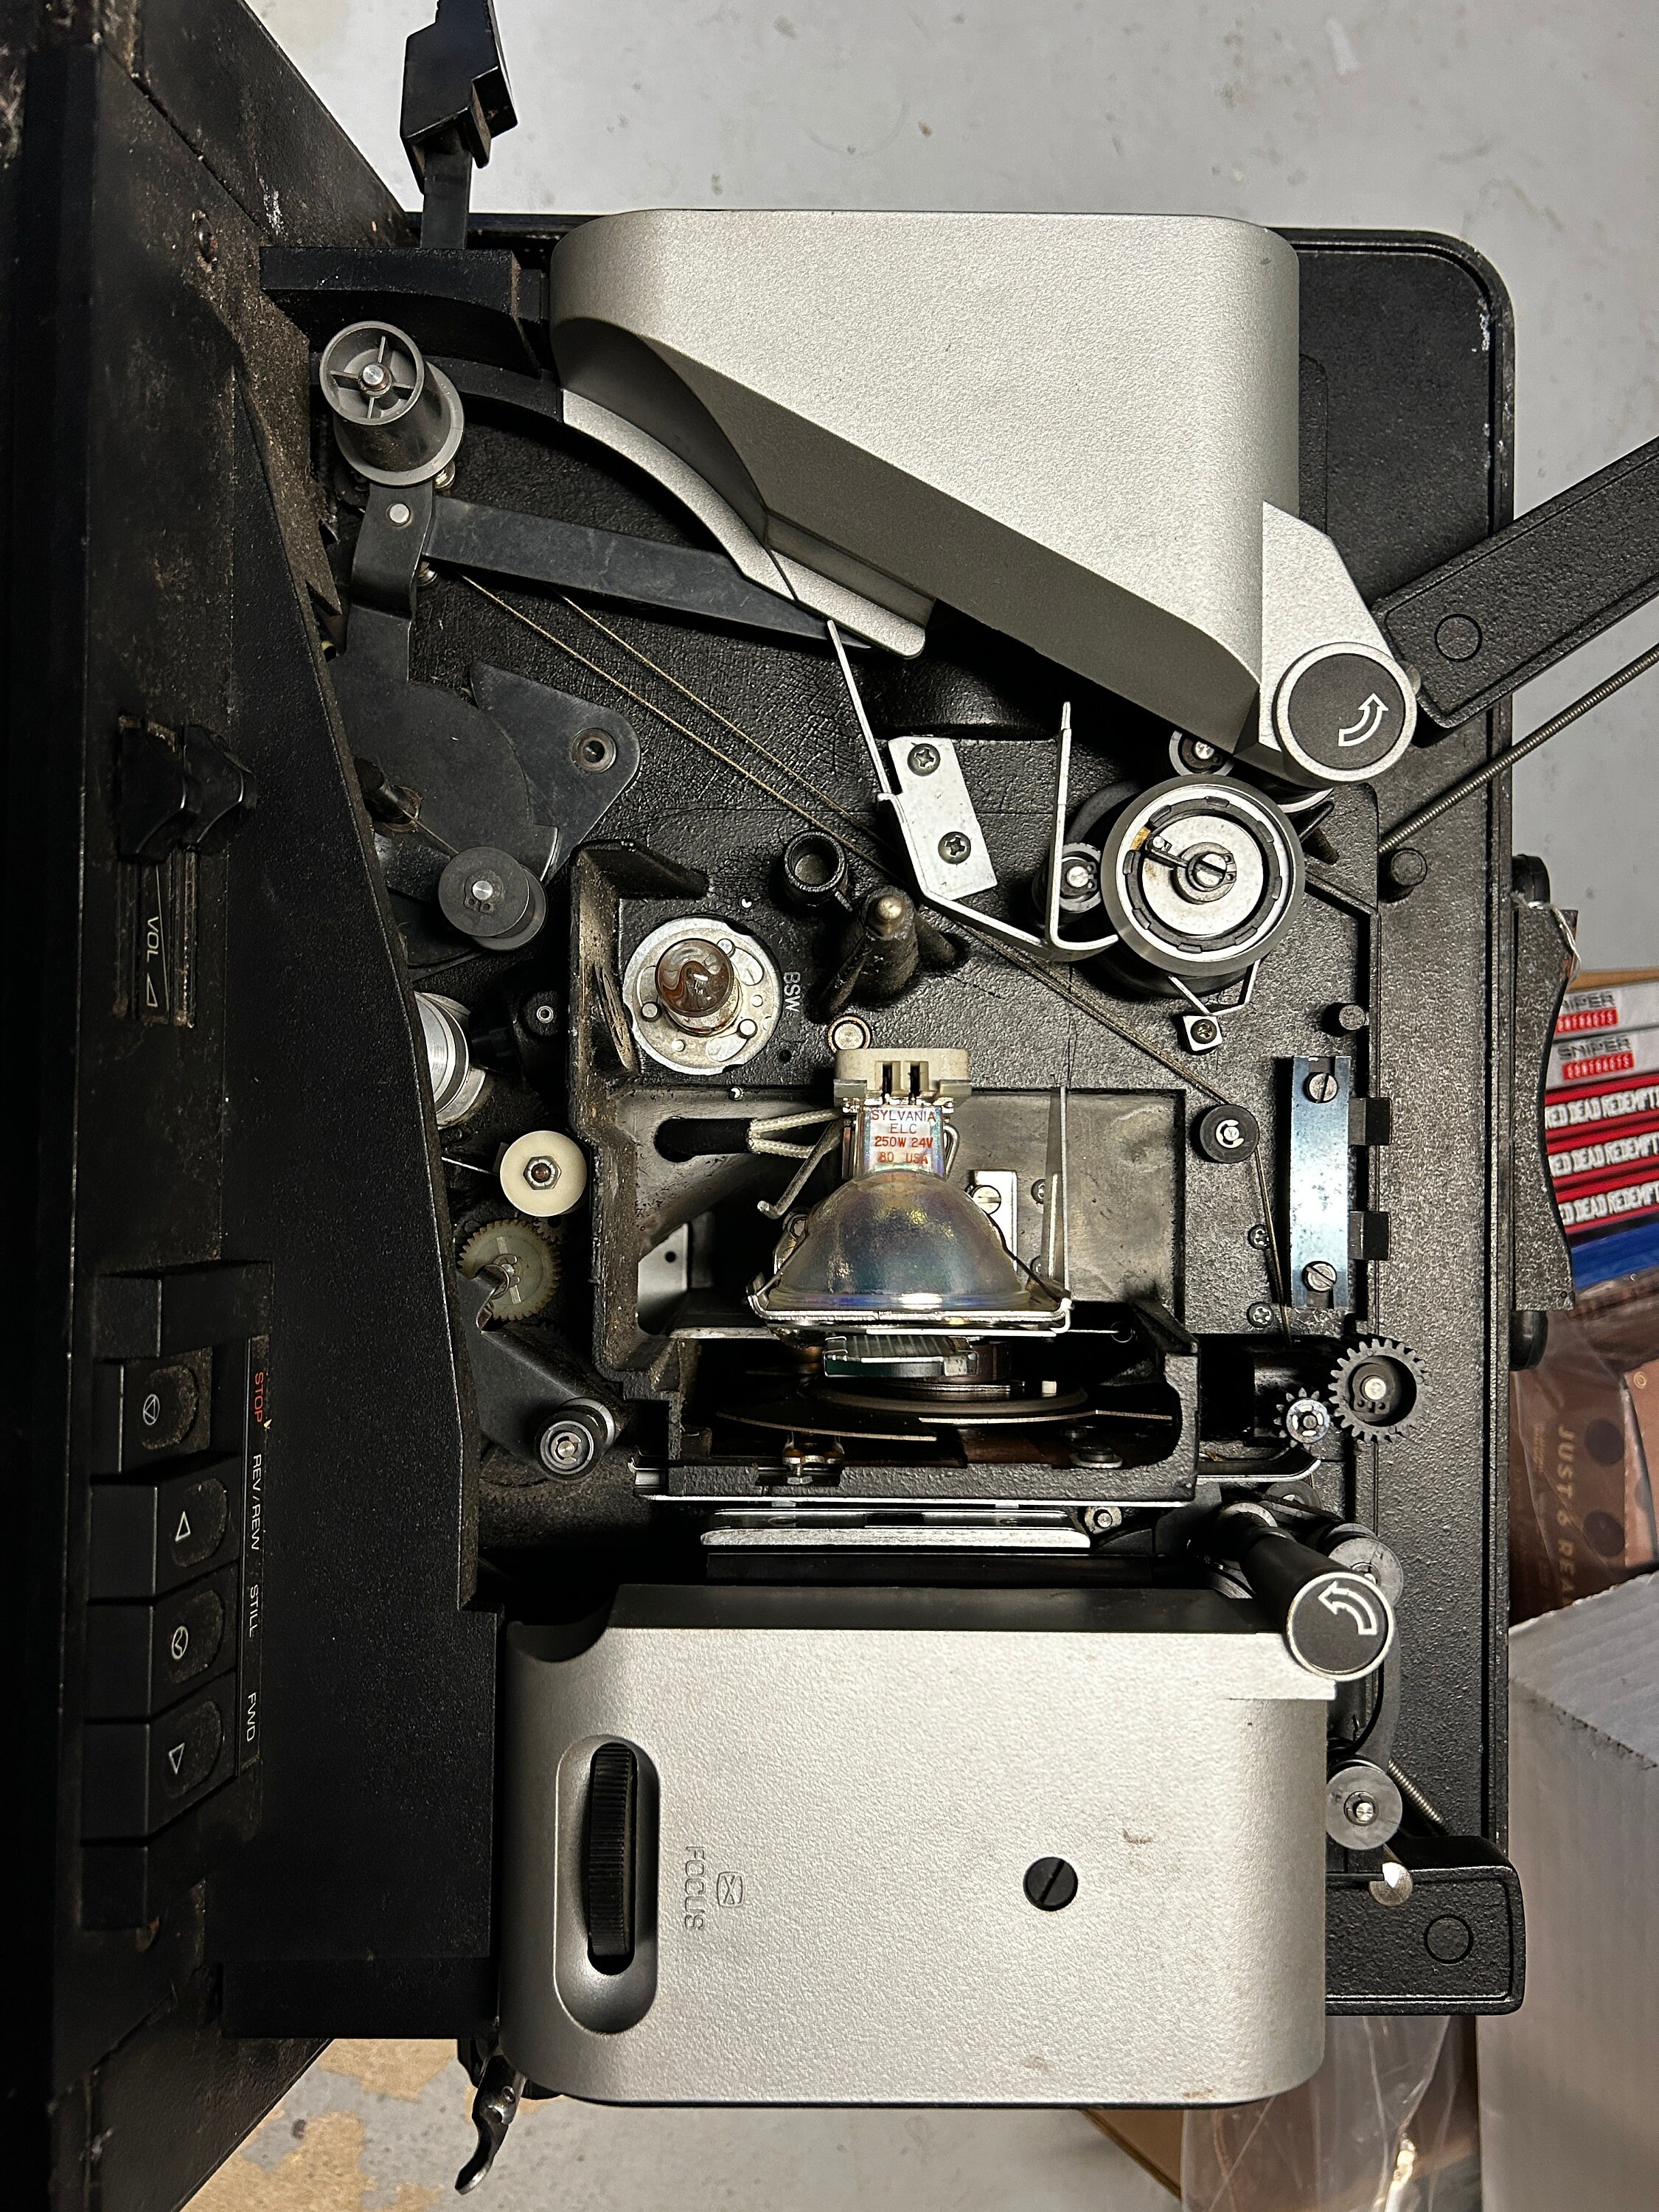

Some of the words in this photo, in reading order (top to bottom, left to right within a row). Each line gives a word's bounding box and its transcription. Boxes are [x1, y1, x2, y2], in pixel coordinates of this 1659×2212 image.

[147, 917, 159, 962] VOL
[1562, 991, 1615, 1011] NIPER
[1557, 1010, 1613, 1032] ONTRACTS
[1557, 1034, 1632, 1060] SNIPER
[871, 1110, 936, 1122] SYLVANIA
[1568, 1096, 1601, 1124] DEAD
[874, 1136, 906, 1147] 250W
[911, 1137, 933, 1148] 24V
[890, 1123, 917, 1134] ELC
[905, 1153, 928, 1164] USA
[1571, 1144, 1605, 1172] DEAD
[1574, 1194, 1608, 1222] DEAD
[254, 1371, 264, 1423] STOP
[1556, 1423, 1576, 1499] JUST
[1557, 1538, 1576, 1606] REA
[249, 1585, 258, 1638] STILL
[247, 1692, 257, 1742] FWD
[685, 1846, 706, 1930] FOCUS
